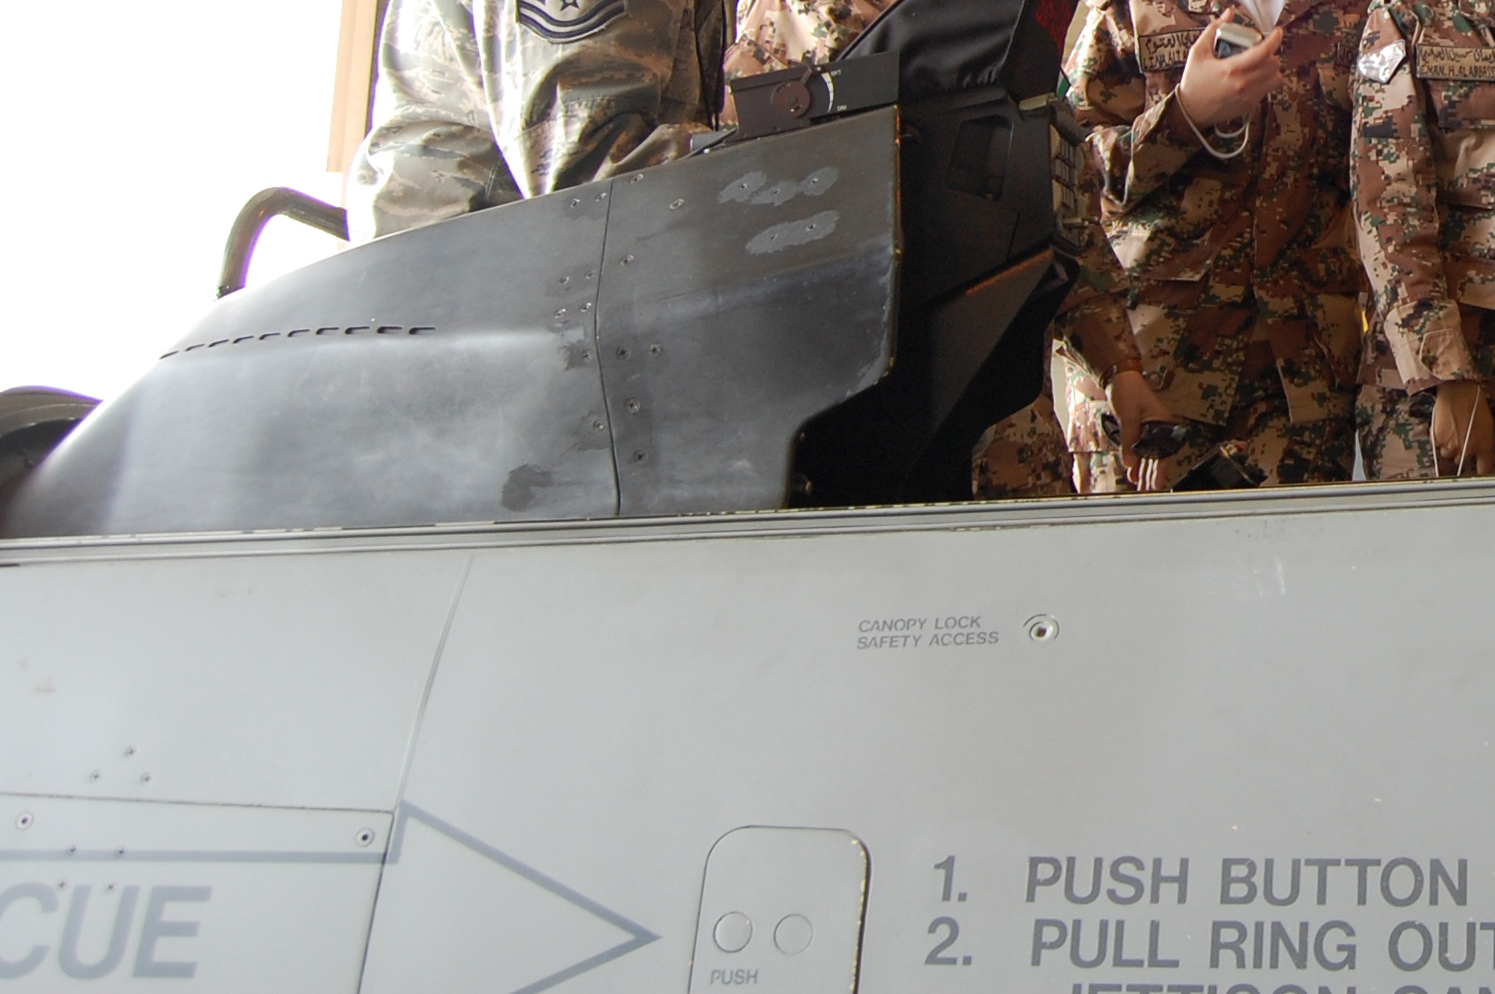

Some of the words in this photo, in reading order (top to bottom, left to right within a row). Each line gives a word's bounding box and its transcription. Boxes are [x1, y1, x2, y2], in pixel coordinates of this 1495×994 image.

[857, 634, 921, 649] SAFETY
[929, 631, 999, 647] ACCESS
[858, 618, 927, 633] CANOPY
[934, 615, 982, 630] LOCK
[934, 856, 967, 903] 1.
[1026, 856, 1189, 906] PUSH
[1220, 857, 1468, 908] BUTTON
[0, 882, 213, 980] CUE
[925, 916, 973, 966] 2.
[1031, 918, 1180, 969] PULL
[1209, 920, 1357, 972] RING
[710, 969, 758, 985] PUSH
